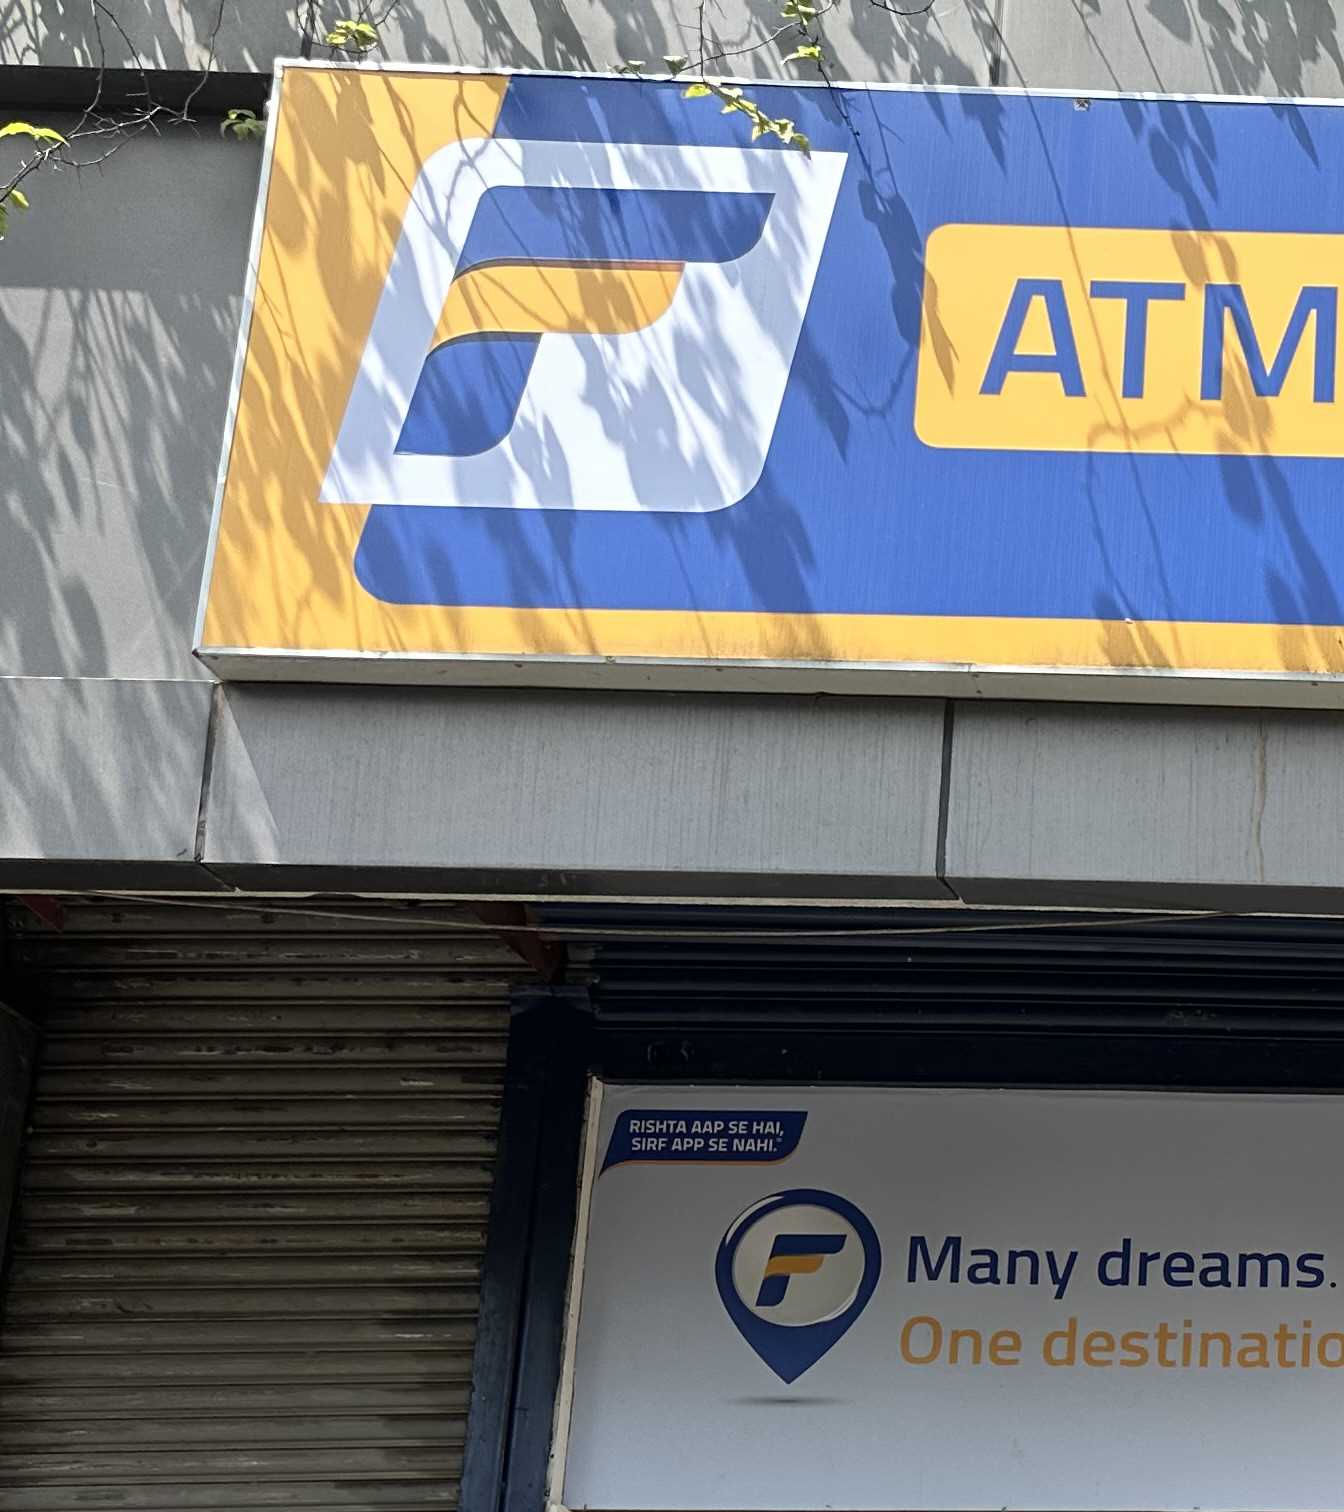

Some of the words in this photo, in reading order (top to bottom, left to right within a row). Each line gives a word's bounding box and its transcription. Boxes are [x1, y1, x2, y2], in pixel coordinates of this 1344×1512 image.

[978, 275, 1341, 405] ATM
[629, 1119, 687, 1134] RISHTA
[691, 1120, 724, 1134] AAP
[728, 1121, 748, 1134] SE
[753, 1121, 784, 1136] HAI,
[632, 1137, 666, 1151] SIRF
[671, 1138, 704, 1151] APP
[709, 1138, 728, 1151] SE
[907, 1235, 1078, 1299] Many
[1098, 1238, 1337, 1289] dreams.
[900, 1316, 1022, 1366] One
